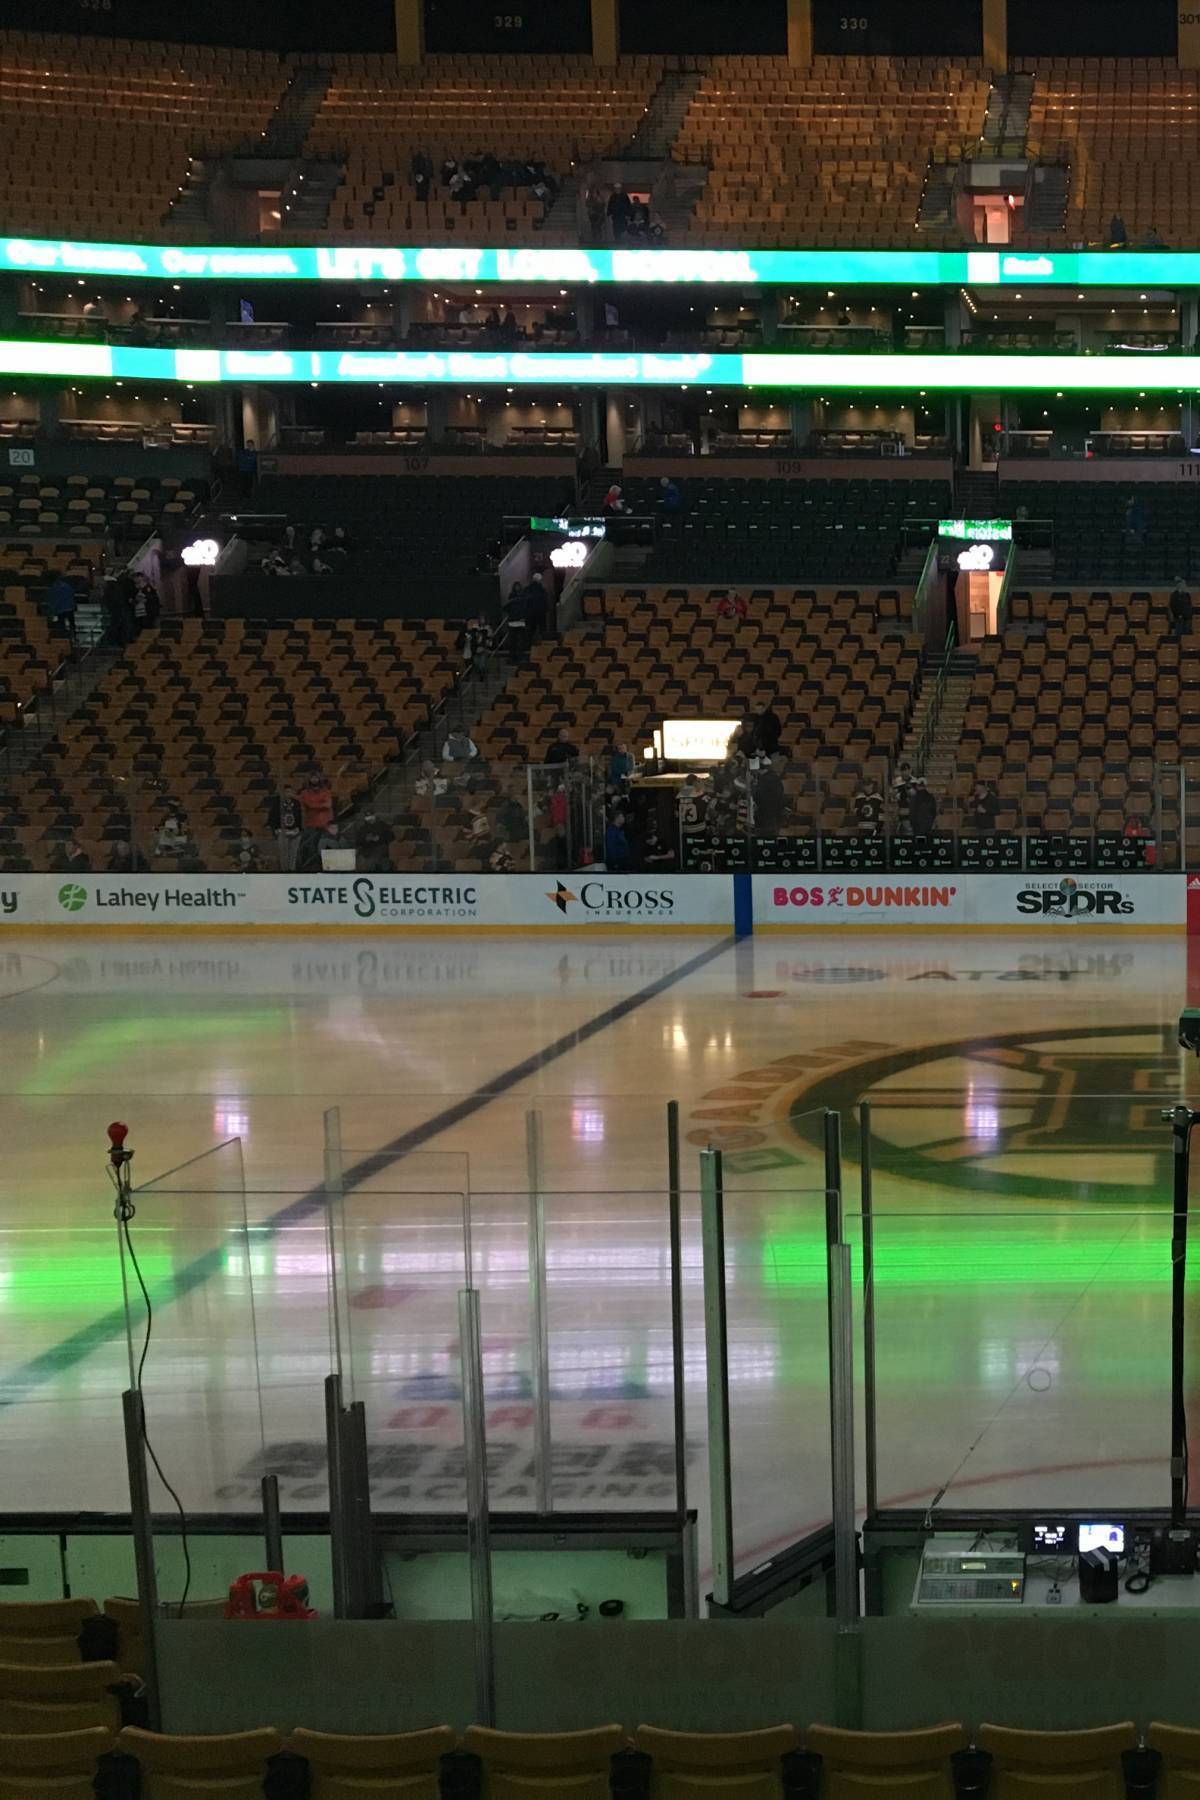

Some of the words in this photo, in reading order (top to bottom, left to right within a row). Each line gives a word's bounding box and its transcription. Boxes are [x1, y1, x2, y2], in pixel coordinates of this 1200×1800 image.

[494, 15, 523, 28] 329
[840, 18, 869, 30] 330
[1179, 13, 1200, 25] 301
[12, 450, 31, 464] 20
[403, 458, 429, 471] 107
[1179, 463, 1200, 476] 111
[1025, 882, 1059, 890] SELECT
[1077, 882, 1114, 890] SECTOR
[96, 888, 157, 910] Lahey
[165, 889, 236, 907] Health
[288, 887, 348, 904] STATE
[773, 887, 824, 906] BOS
[845, 886, 956, 907] DUNKIN'
[380, 907, 477, 917] CORPORATION
